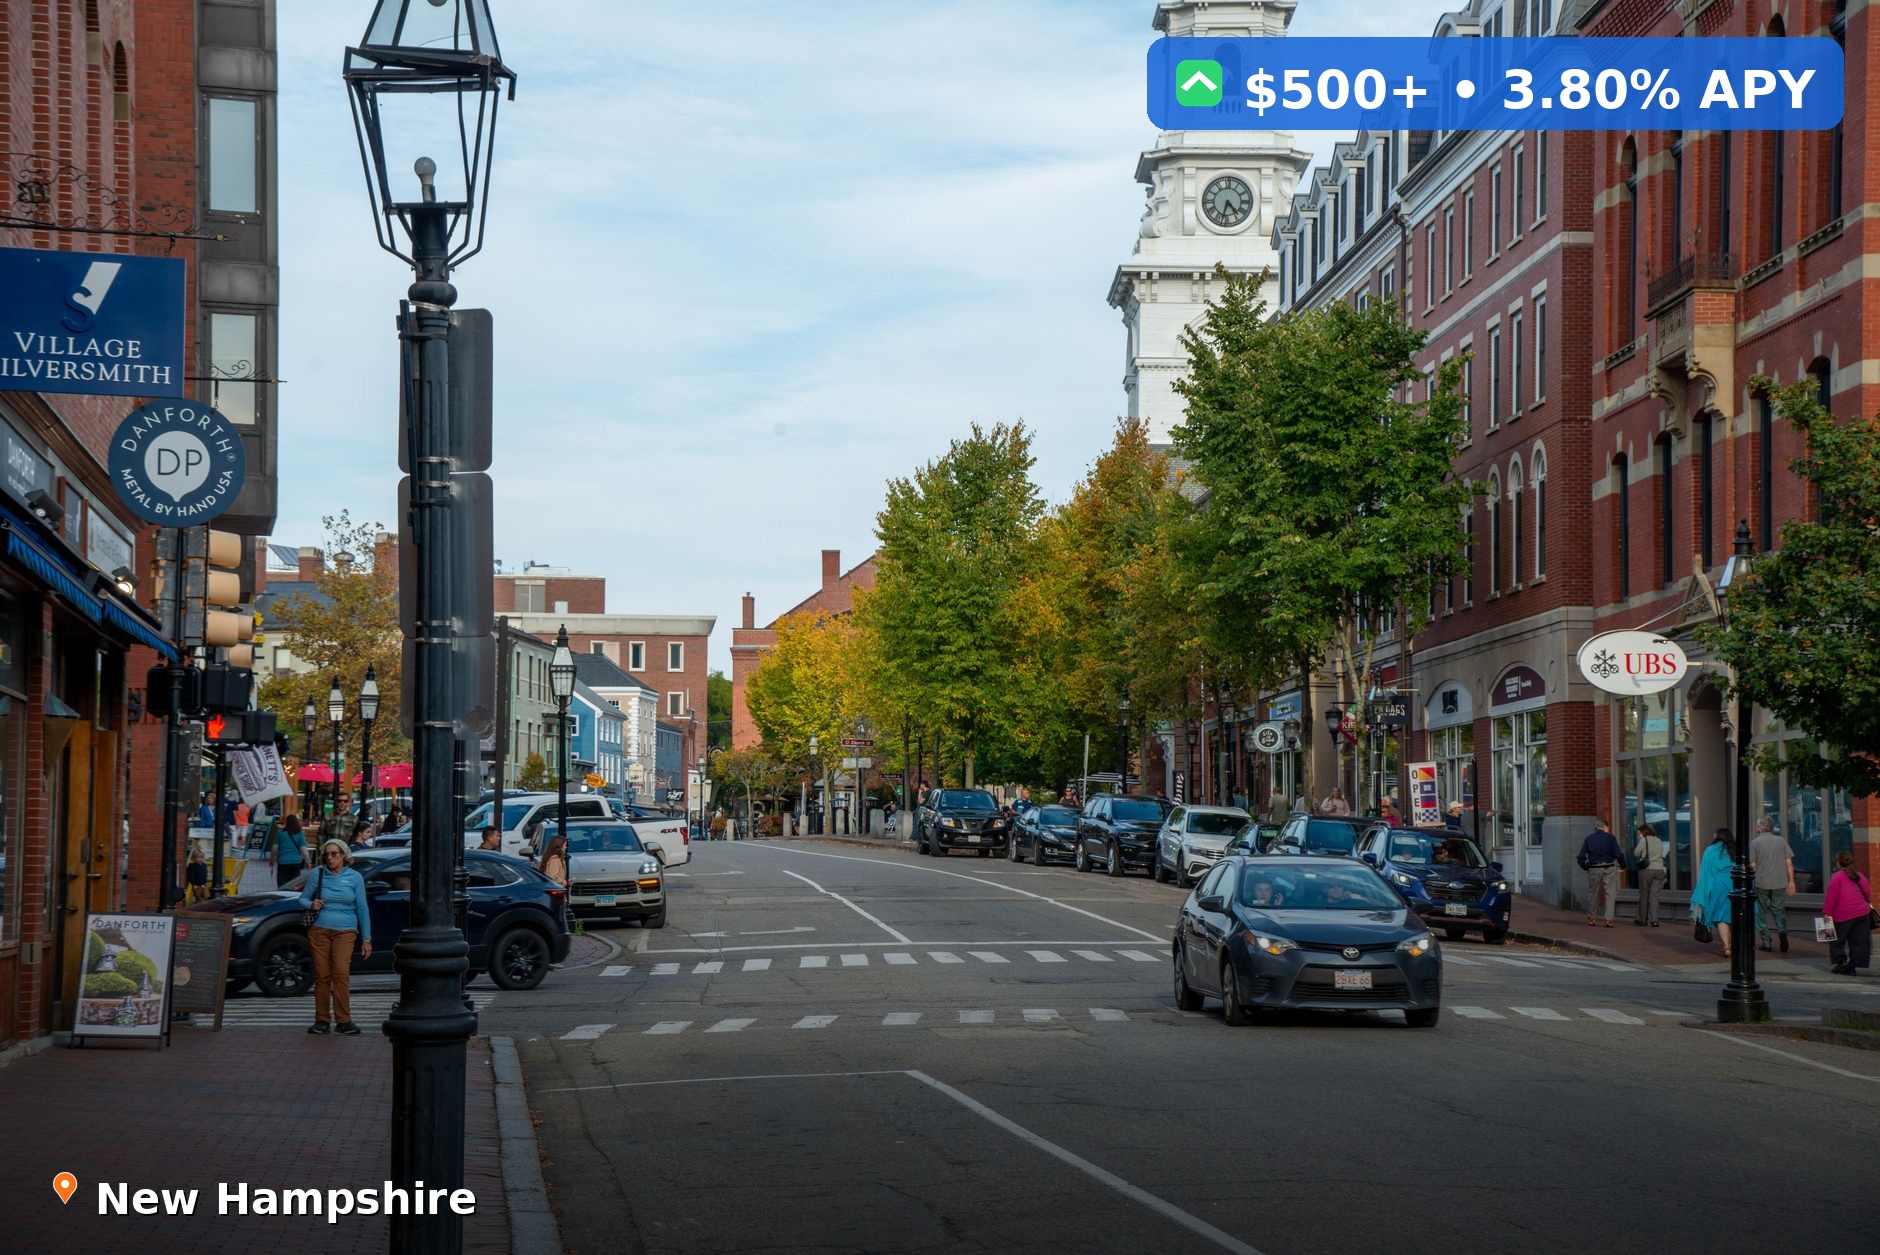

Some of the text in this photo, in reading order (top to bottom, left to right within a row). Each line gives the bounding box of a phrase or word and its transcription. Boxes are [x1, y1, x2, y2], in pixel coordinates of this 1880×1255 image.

[13, 331, 142, 358] VILLAGE
[0, 358, 172, 386] ILVERSMITH
[121, 407, 232, 453] DANFORTH
[157, 448, 203, 477] DP
[121, 468, 234, 517] METAL BY HAND USA
[1623, 652, 1677, 676] UBS
[240, 774, 254, 791] SHOP
[1411, 769, 1422, 822] OPEN
[95, 920, 165, 930] DANFORTH
